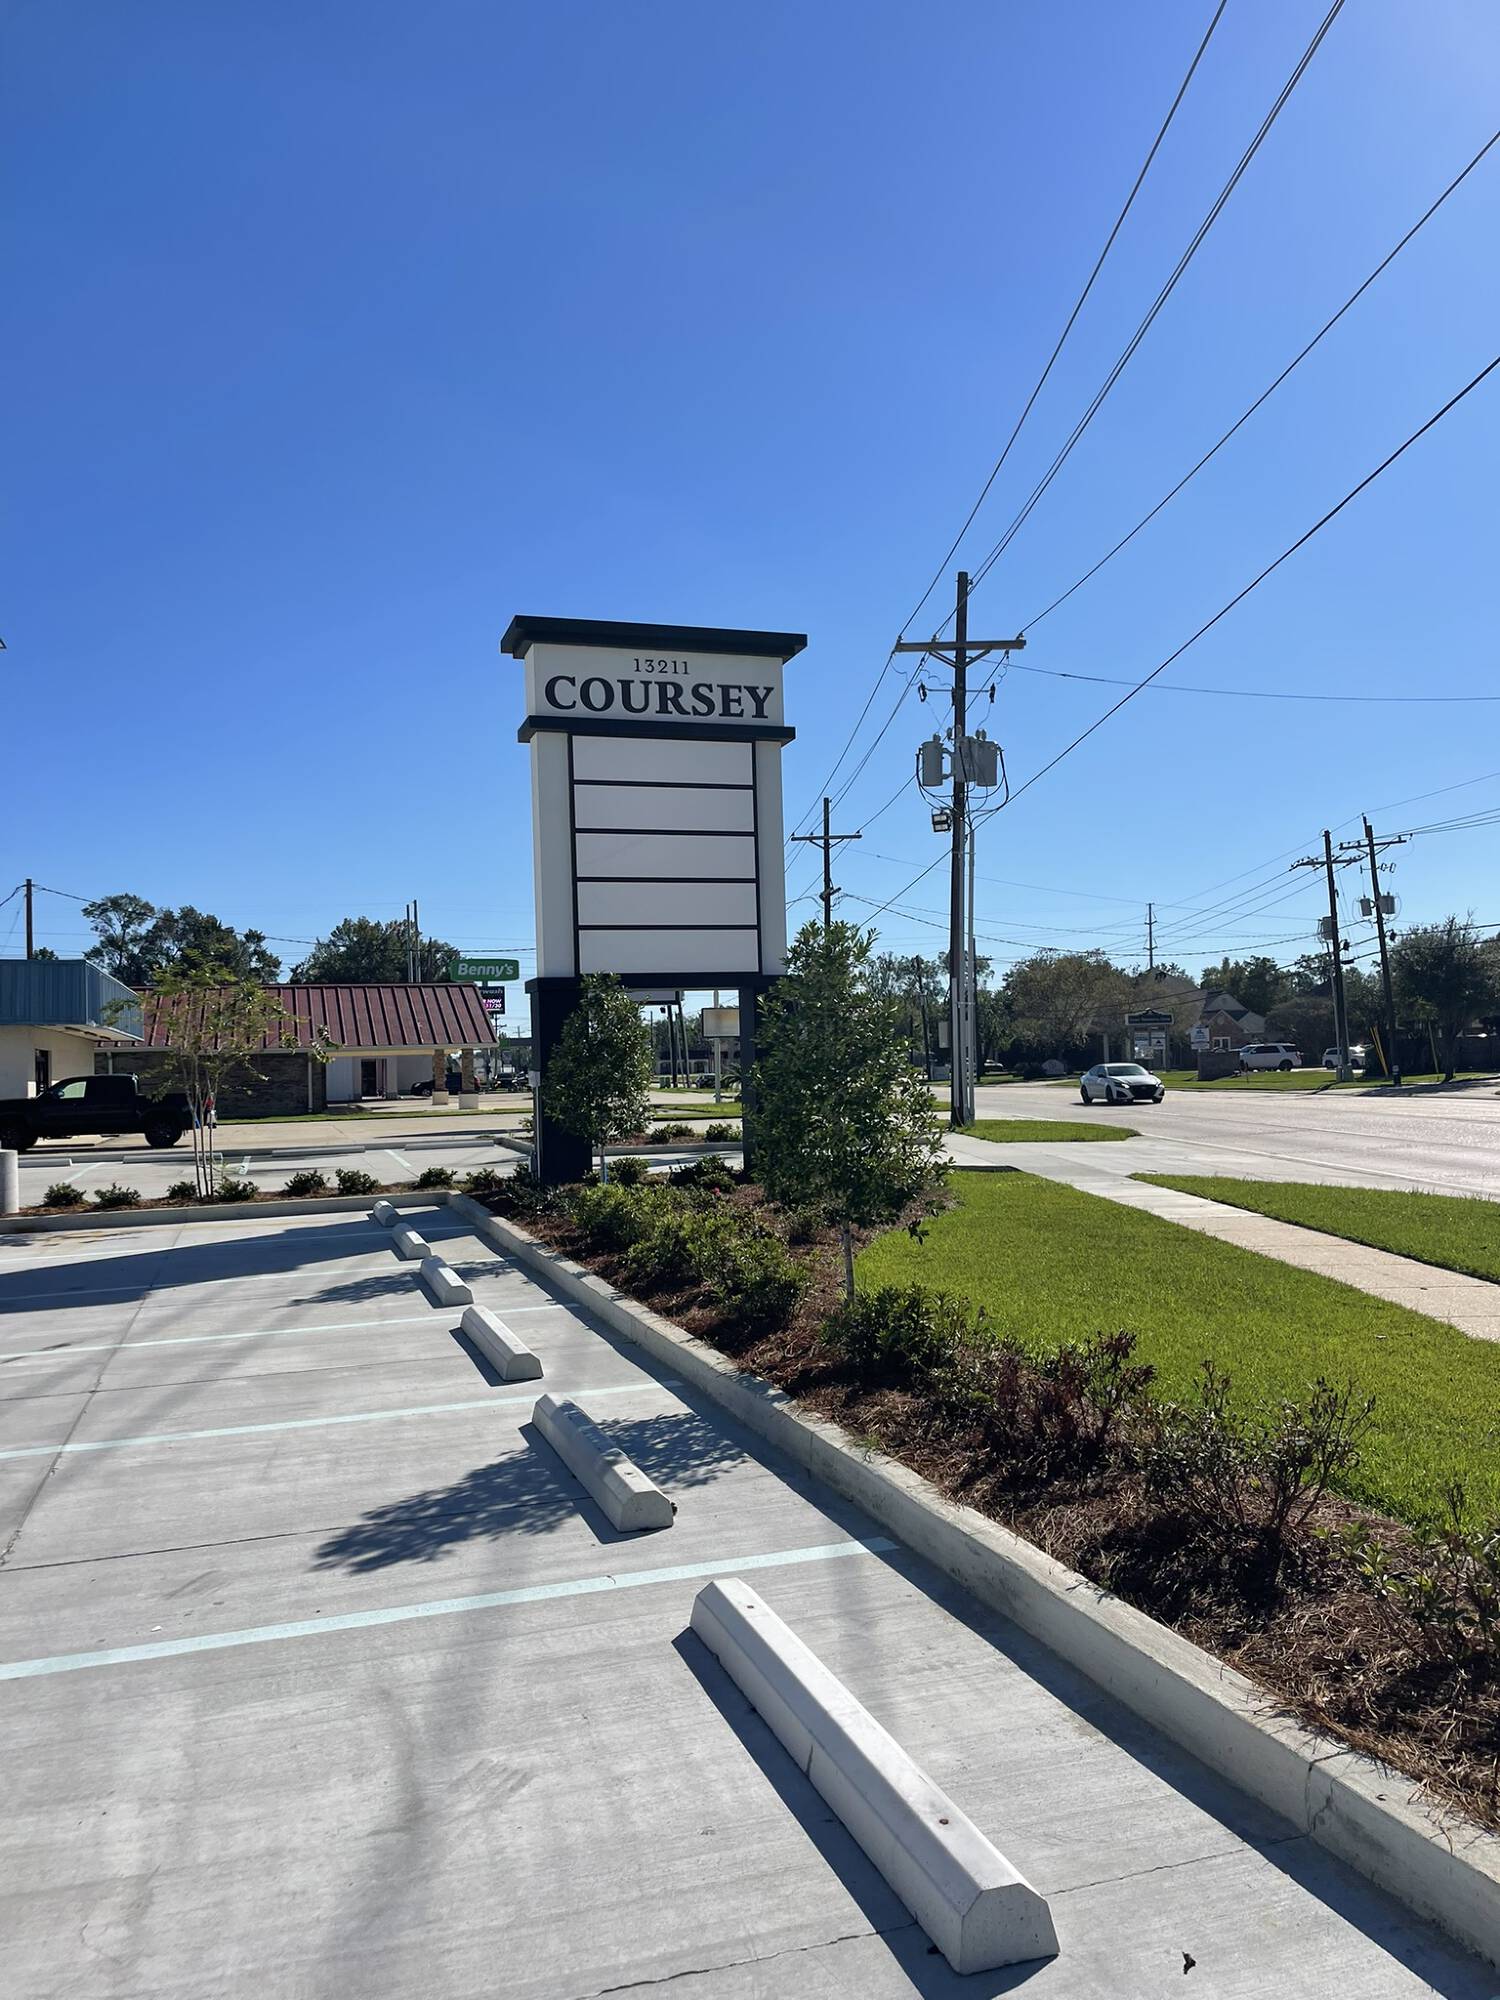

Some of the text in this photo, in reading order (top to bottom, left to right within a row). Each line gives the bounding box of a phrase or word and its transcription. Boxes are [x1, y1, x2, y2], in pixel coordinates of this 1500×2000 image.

[634, 658, 690, 675] 13211
[545, 675, 775, 719] COURSEY
[458, 963, 514, 977] Benny's
